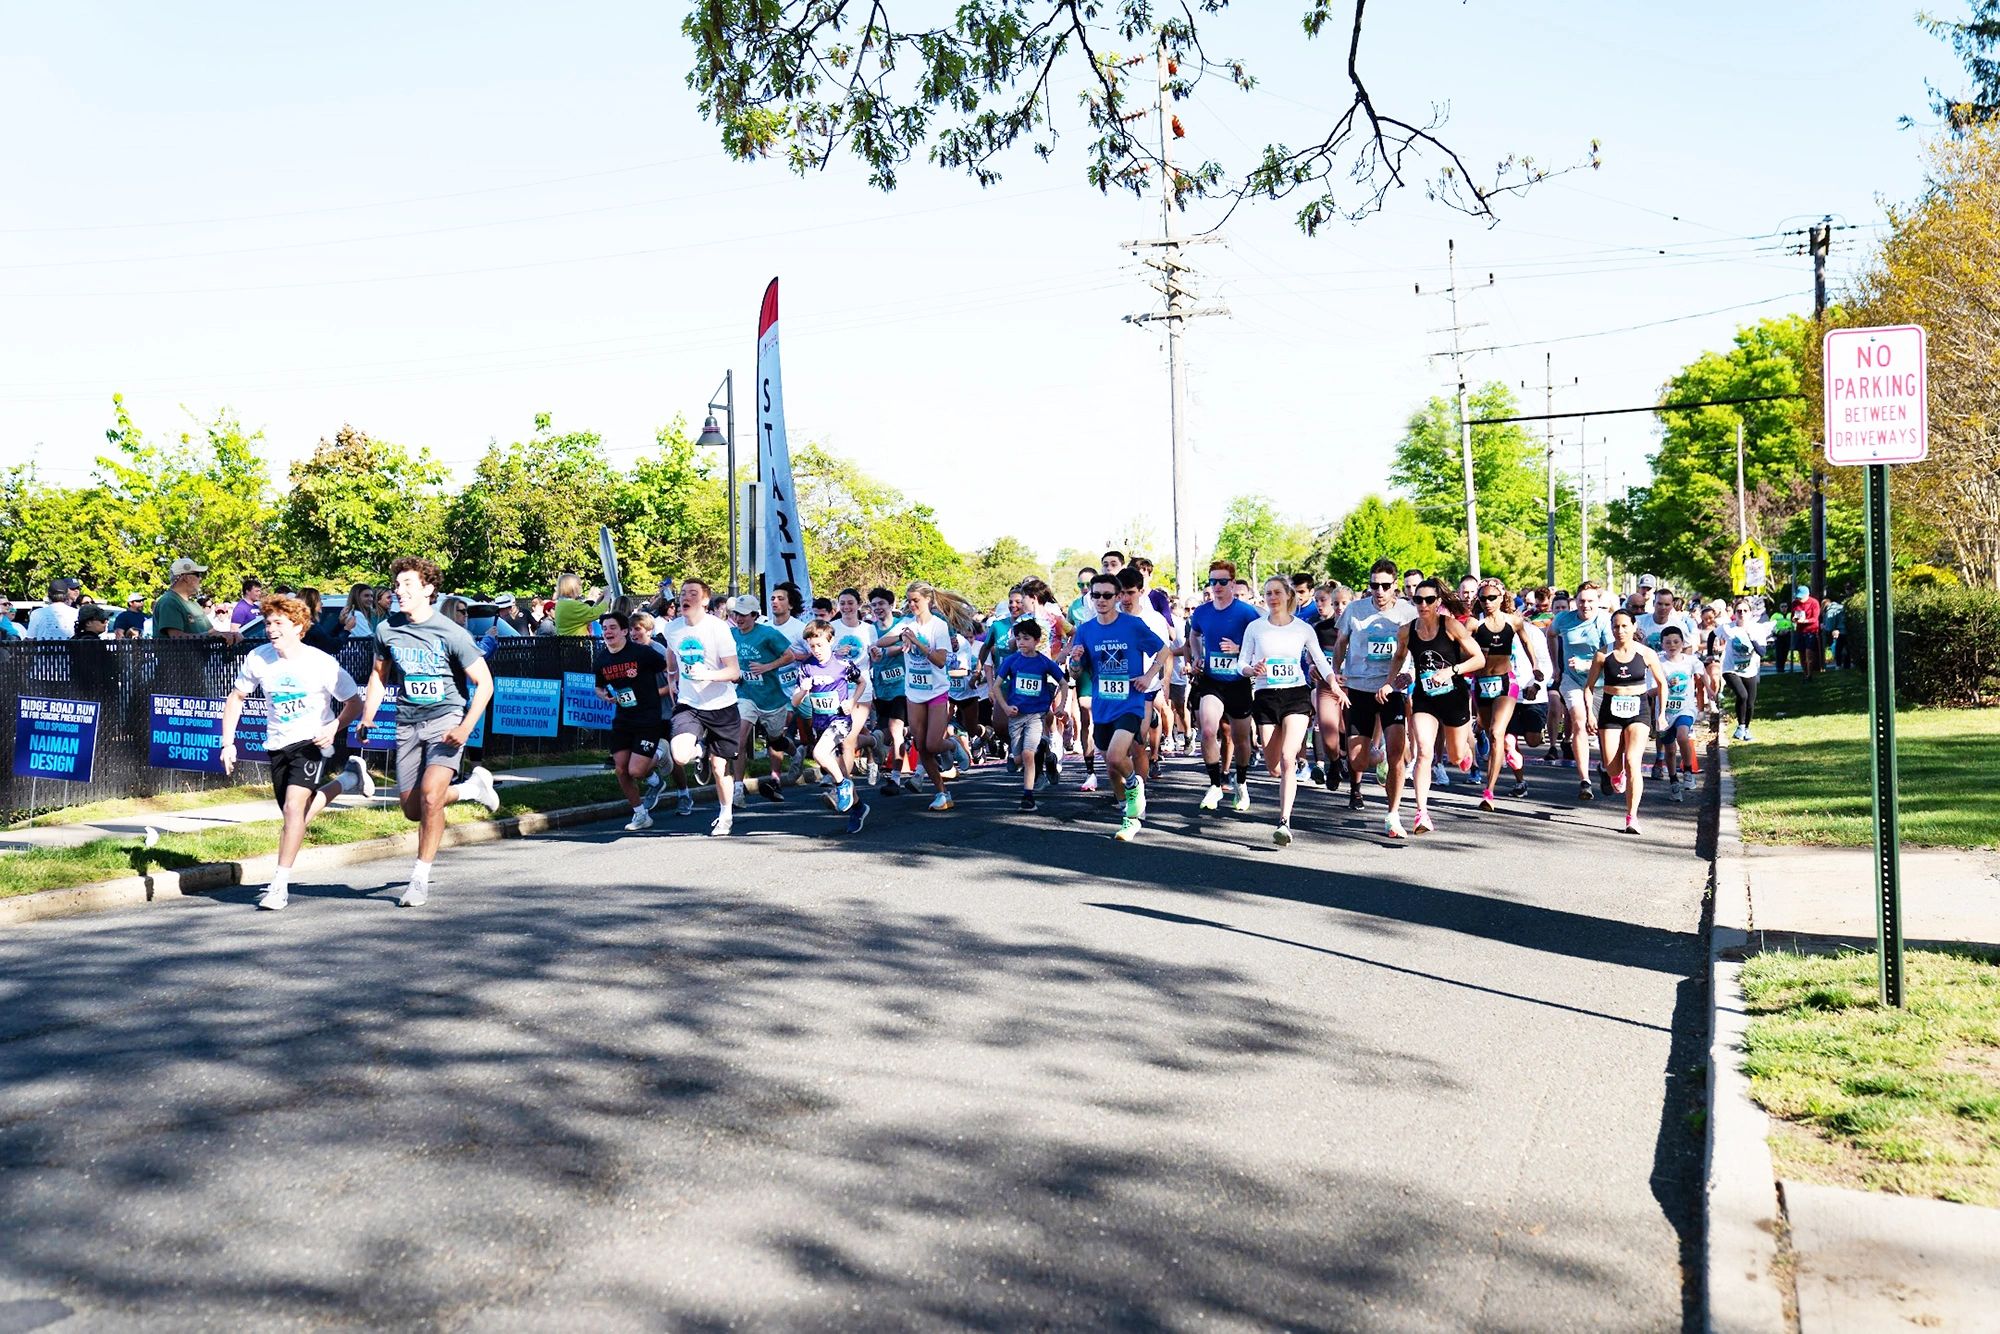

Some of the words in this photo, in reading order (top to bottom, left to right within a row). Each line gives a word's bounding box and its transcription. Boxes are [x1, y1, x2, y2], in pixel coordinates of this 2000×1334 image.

[1857, 345, 1892, 369] NO
[1835, 374, 1916, 400] PARKING
[1845, 405, 1907, 423] BETWEEN
[1836, 428, 1917, 447] DRIVEWAYS
[763, 378, 797, 584] START
[1107, 643, 1128, 651] BANG
[1373, 642, 1393, 654] 279
[391, 645, 446, 667] DUKE
[602, 661, 638, 675] AUBURN
[1214, 658, 1233, 668] 147
[885, 669, 901, 679] 808
[1272, 664, 1295, 677] 638
[498, 679, 520, 688] RIDGE
[521, 681, 541, 689] ROAD
[543, 681, 558, 690] RUN
[567, 674, 585, 683] RIDGE
[586, 675, 595, 683] RO
[912, 673, 928, 685] 391
[1020, 679, 1039, 691] 169
[411, 682, 437, 695] 626
[1104, 681, 1124, 693] 183
[21, 699, 48, 711] RIDGE
[50, 702, 74, 713] ROAD
[76, 704, 96, 716] RUN
[154, 697, 180, 708] RIDGE
[183, 699, 207, 710] ROAD
[281, 699, 306, 714] 374
[566, 697, 613, 711] TRILLIUM
[1616, 702, 1636, 712] 568
[21, 710, 28, 719] 5K
[29, 711, 40, 719] FOR
[40, 712, 60, 721] SUICIDE
[61, 714, 93, 724] PREVENTION
[163, 708, 173, 716] FOR
[174, 709, 193, 717] SUICIDE
[496, 704, 521, 715] TIGGER
[523, 706, 557, 717] STAVOLA
[168, 717, 185, 726] GOLD
[185, 718, 213, 728] SPONSOR
[501, 717, 549, 729] FOUNDATION
[567, 711, 611, 725] TRADING
[35, 721, 50, 731] GOLD
[51, 723, 79, 733] SPONSOR
[29, 734, 79, 754] NAIMAN
[153, 730, 181, 745] ROAD
[168, 746, 209, 761] SPORTS
[30, 753, 75, 773] DESIGN
